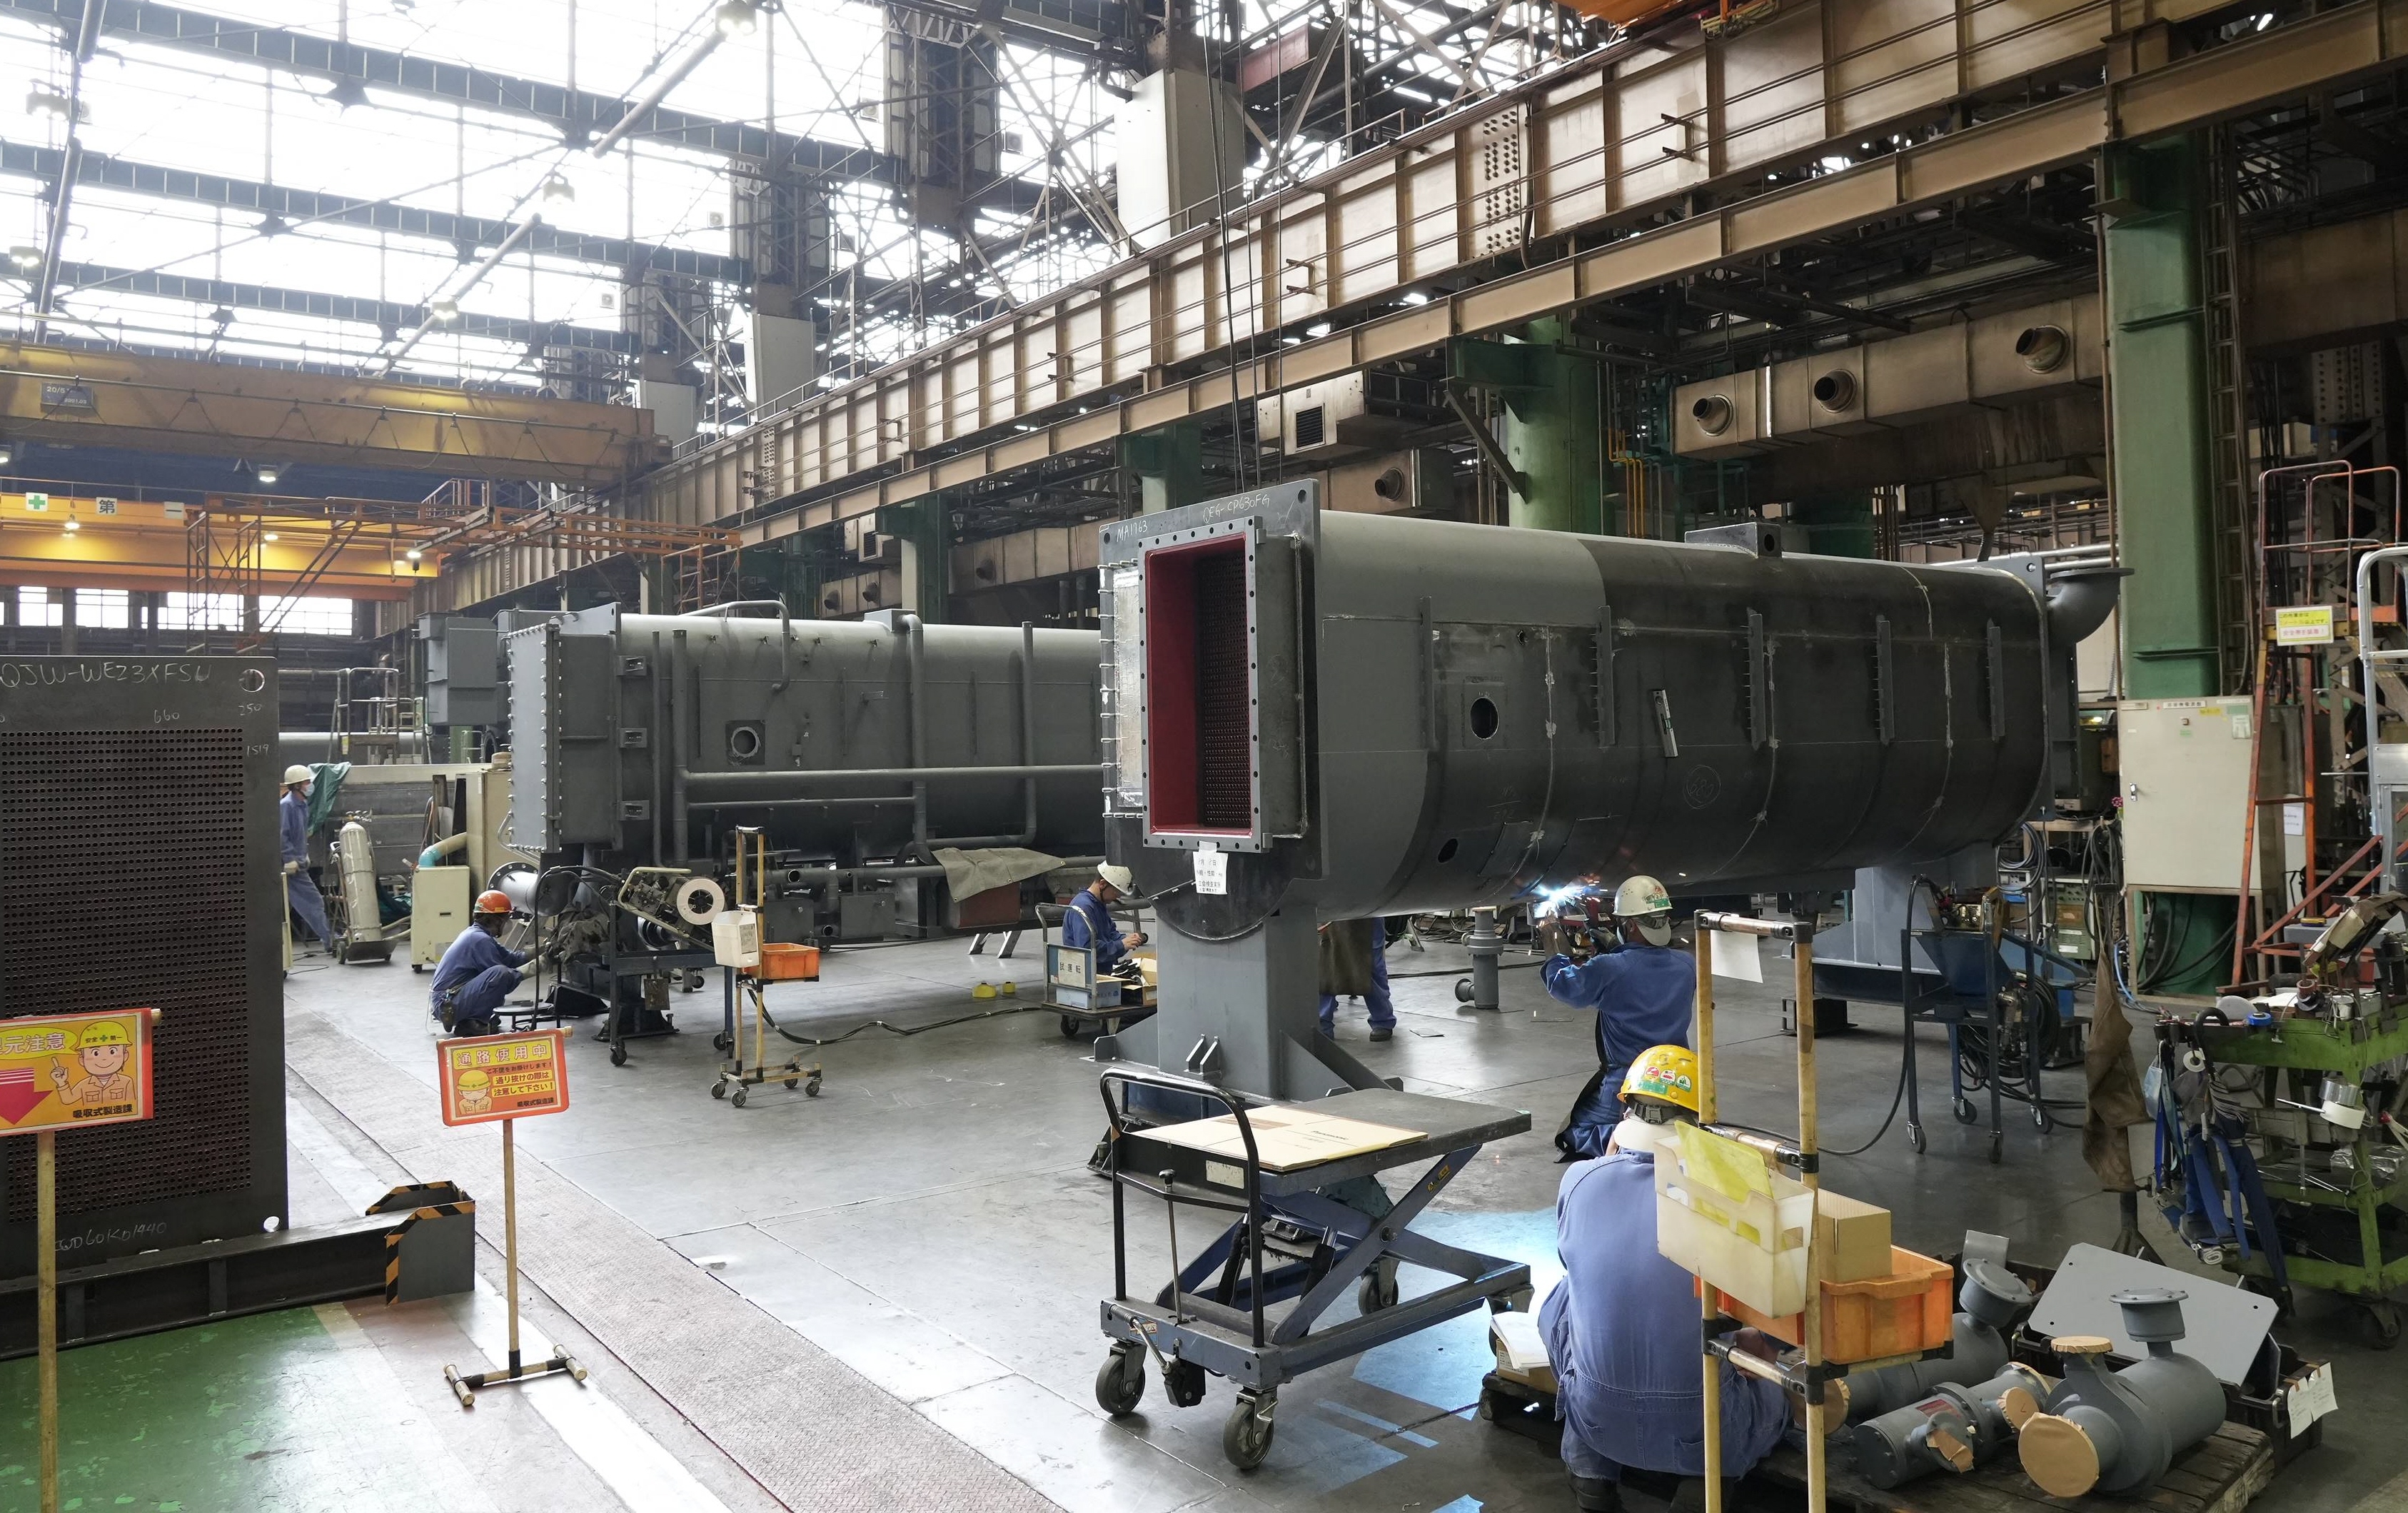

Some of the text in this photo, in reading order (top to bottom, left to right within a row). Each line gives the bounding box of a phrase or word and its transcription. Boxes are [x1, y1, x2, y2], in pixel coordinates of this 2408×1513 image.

[0, 1032, 65, 1055] 元注意
[457, 1044, 548, 1067] 通路使用中
[72, 1104, 134, 1119] 吸収式製造課
